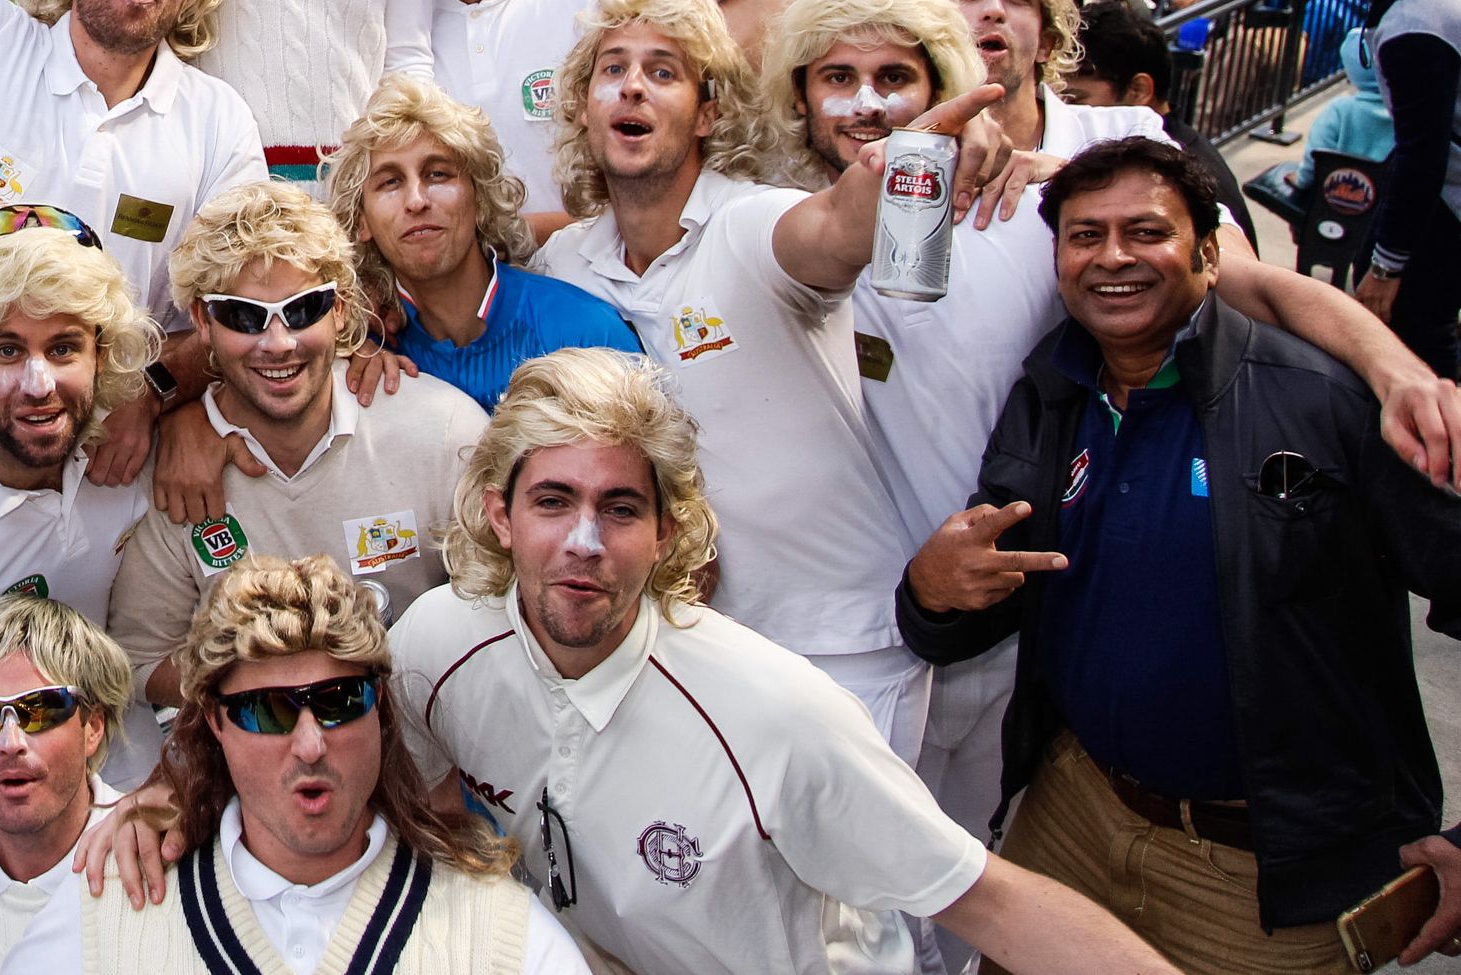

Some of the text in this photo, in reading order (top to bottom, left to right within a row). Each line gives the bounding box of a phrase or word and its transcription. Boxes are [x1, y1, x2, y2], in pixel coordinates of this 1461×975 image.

[895, 175, 932, 186] STELLA
[893, 183, 932, 195] ARTOIS
[204, 530, 233, 551] VB
[211, 547, 245, 567] BITTER
[371, 552, 406, 567] AUSTRALIA
